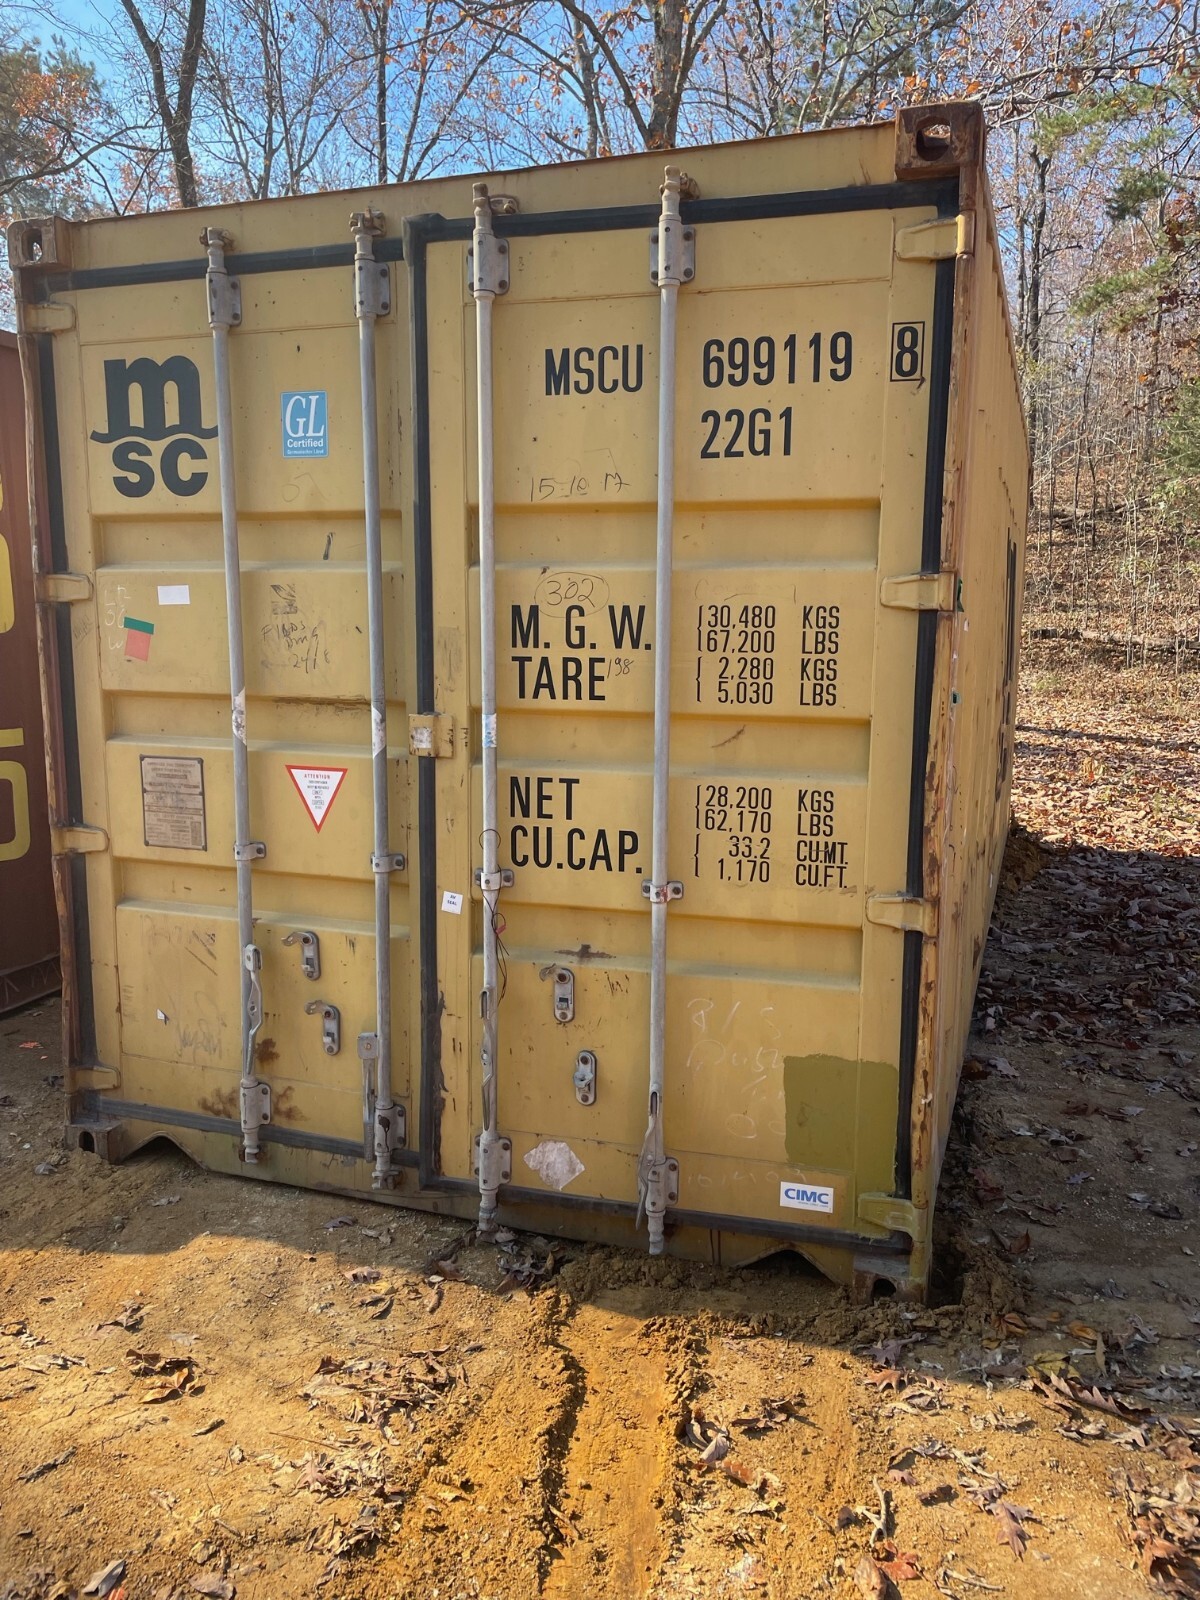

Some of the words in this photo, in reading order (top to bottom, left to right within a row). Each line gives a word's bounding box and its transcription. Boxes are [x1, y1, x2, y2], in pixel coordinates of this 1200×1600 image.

[545, 344, 643, 396] MSCU
[703, 330, 853, 388] 699119
[894, 325, 919, 378] 8
[285, 395, 325, 438] GL
[287, 438, 323, 448] Certified
[700, 406, 792, 458] 22G1
[545, 578, 596, 608] 302
[707, 605, 776, 630] 30,480
[802, 606, 840, 630] KGS
[707, 630, 775, 656] 67,200
[801, 631, 839, 655] LBS
[511, 656, 606, 701] TARE
[718, 656, 774, 682] 2,280
[800, 657, 837, 682] KGS
[718, 681, 773, 706] 5,030
[799, 681, 837, 706] LBS
[510, 776, 580, 820] NET
[705, 785, 772, 810] 28,200
[798, 789, 834, 813] KGS
[704, 809, 771, 834] 62,170
[797, 813, 834, 837] LBS
[729, 836, 771, 859] 33.2
[718, 859, 770, 883] 1,170
[784, 1188, 829, 1205] CIMC
